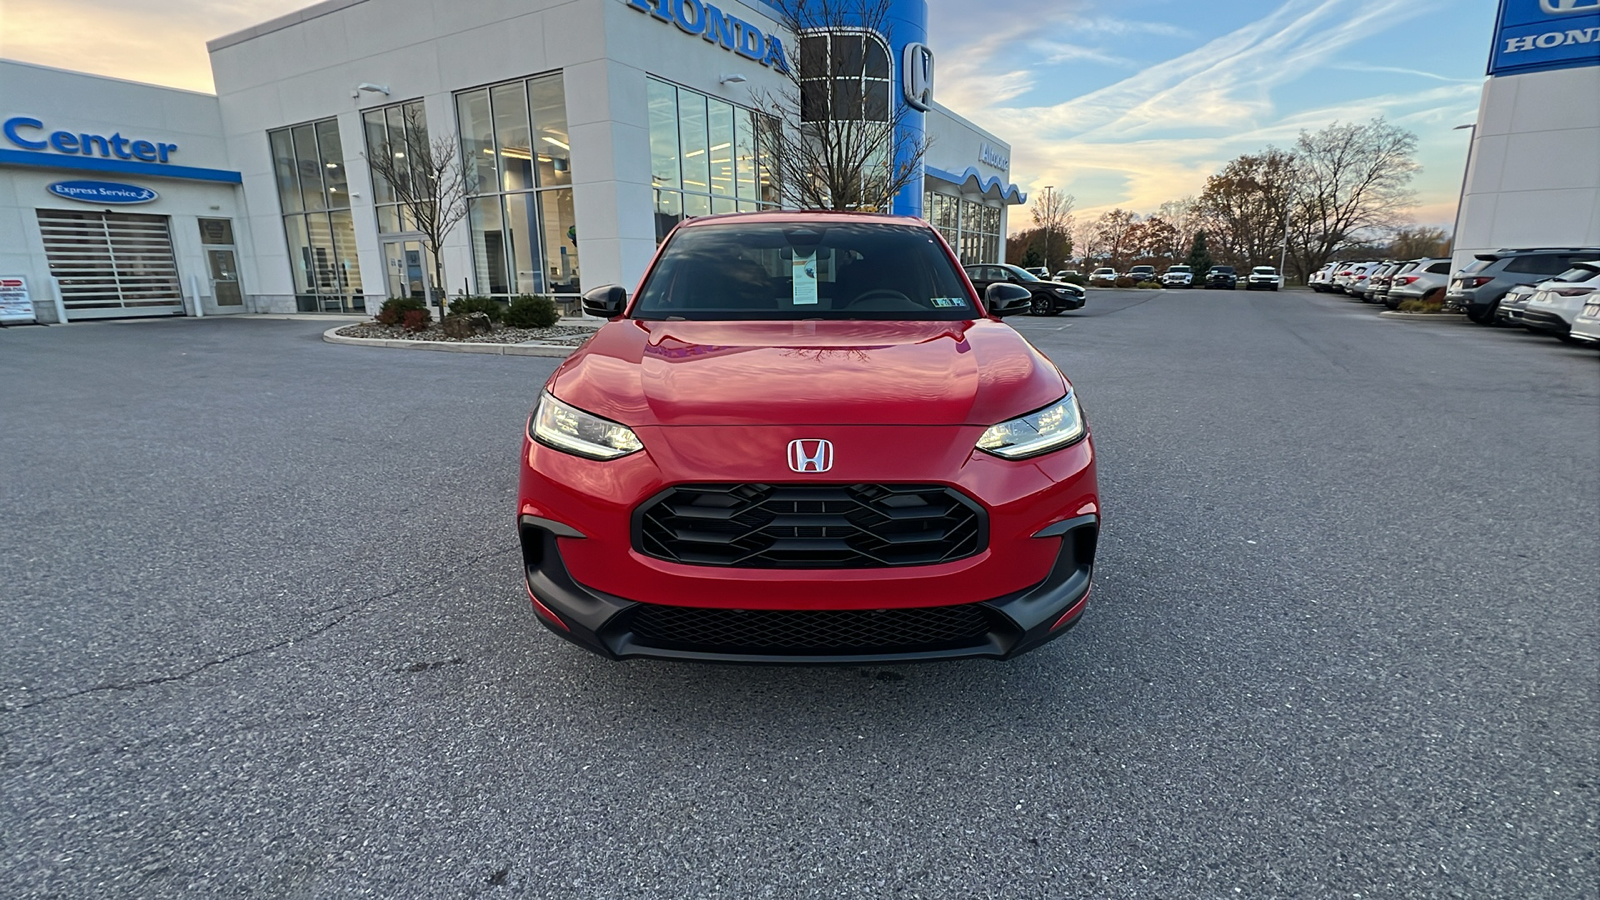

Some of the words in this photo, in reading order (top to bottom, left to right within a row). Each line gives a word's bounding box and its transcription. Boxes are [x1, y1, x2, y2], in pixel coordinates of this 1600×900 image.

[3, 117, 177, 162] Center
[55, 184, 97, 195] Express
[99, 187, 137, 198] Service
